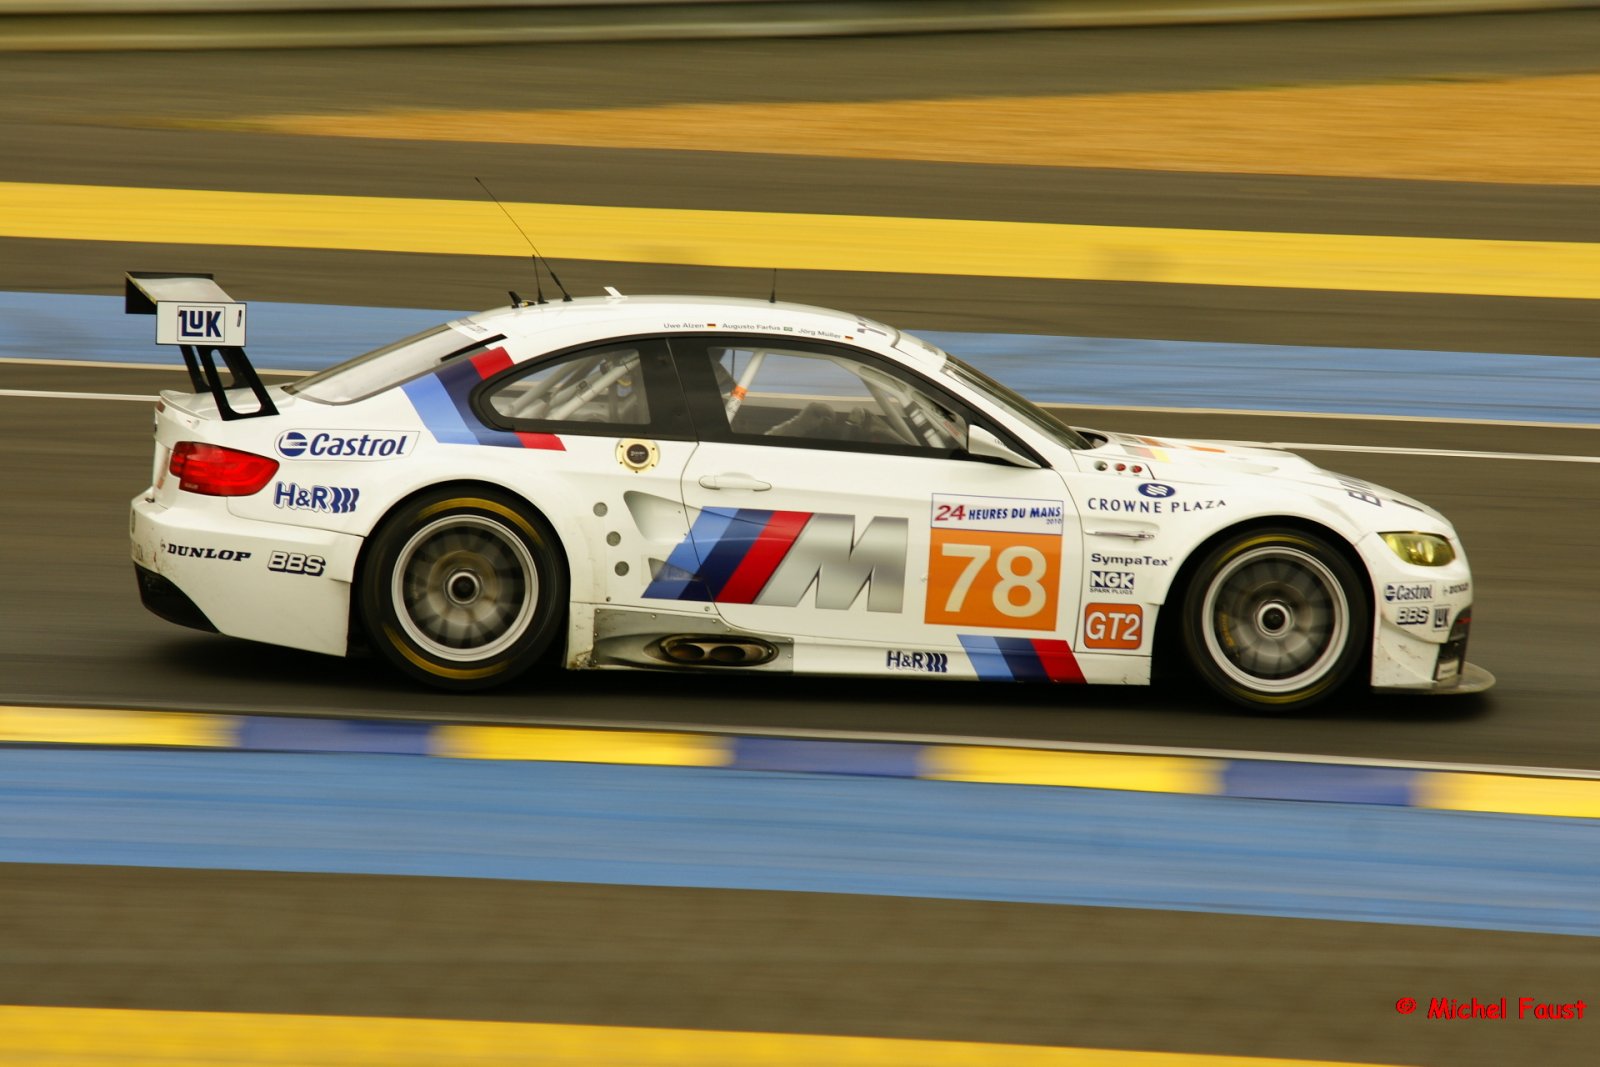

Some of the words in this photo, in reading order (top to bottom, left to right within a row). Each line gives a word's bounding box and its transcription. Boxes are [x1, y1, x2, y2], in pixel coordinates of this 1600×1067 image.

[309, 433, 408, 457] Castrol
[274, 482, 331, 512] H&R
[1088, 498, 1162, 513] CROWNE
[1171, 500, 1227, 513] PLAZA
[934, 505, 966, 521] 24
[968, 508, 1008, 520] HEURES
[1011, 507, 1026, 519] DU
[1029, 506, 1061, 518] MANS
[168, 543, 251, 562] DUNLOP
[267, 551, 326, 577] BBS
[941, 543, 1048, 618] 78
[1091, 571, 1135, 590] NGK
[1397, 584, 1433, 600] Castrol
[1397, 606, 1429, 626] BBS
[1085, 612, 1140, 641] GT2
[886, 650, 925, 671] H&R
